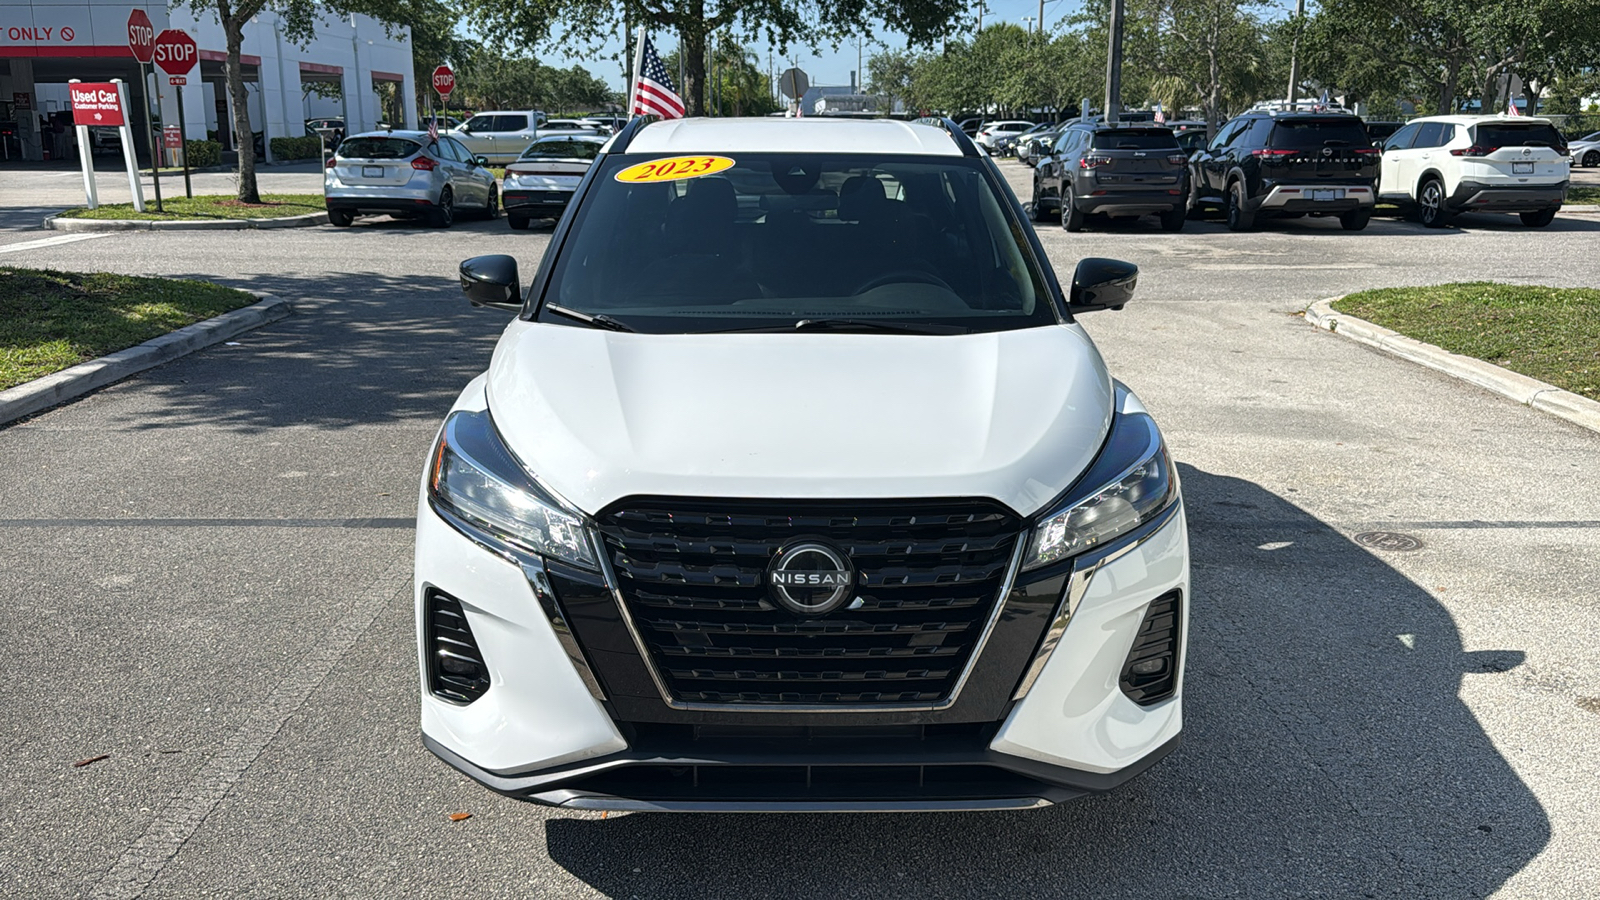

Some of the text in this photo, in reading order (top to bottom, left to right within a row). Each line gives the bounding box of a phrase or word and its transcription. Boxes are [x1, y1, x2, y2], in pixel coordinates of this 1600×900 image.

[8, 26, 54, 41] ONLY
[129, 24, 153, 47] STOP
[156, 43, 195, 61] STOP
[434, 75, 453, 87] STOP
[71, 89, 118, 103] Used Car
[74, 102, 119, 112] Customer Parking
[634, 158, 716, 180] 2023
[772, 572, 849, 585] NISSAN
